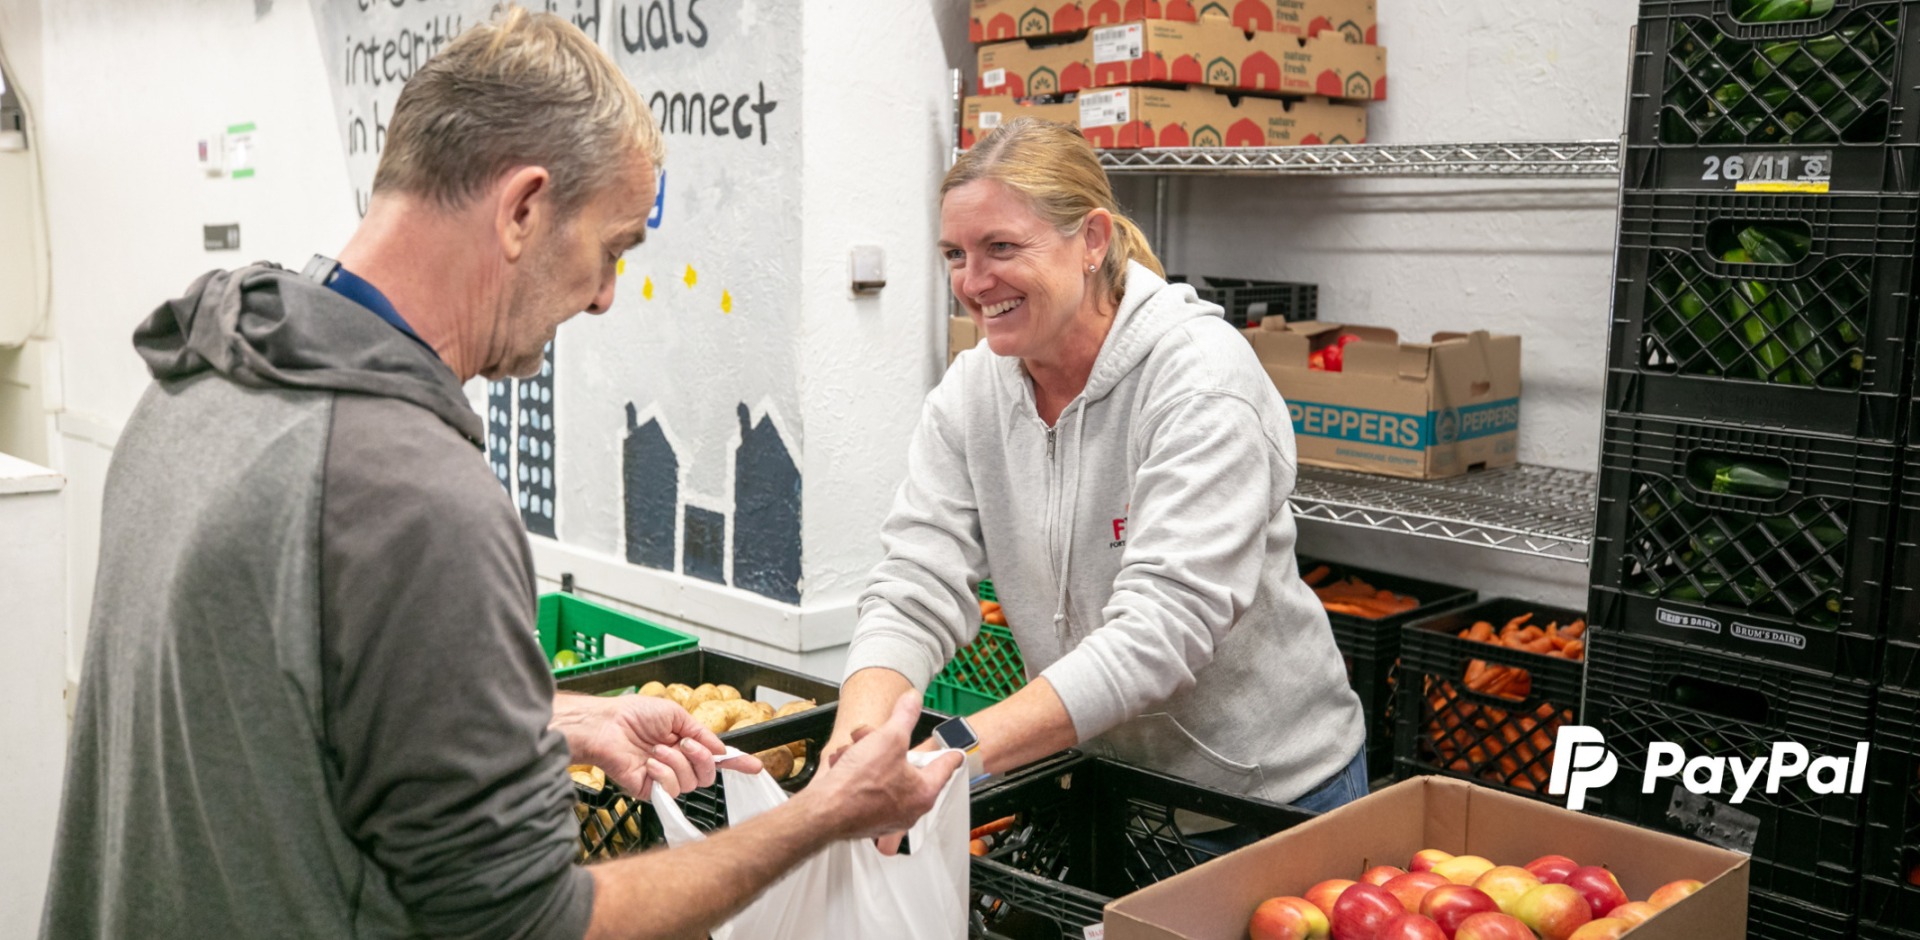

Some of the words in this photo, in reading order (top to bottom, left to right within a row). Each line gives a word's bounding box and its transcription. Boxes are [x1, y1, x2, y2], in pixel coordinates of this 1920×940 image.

[1284, 51, 1312, 62] nature
[1284, 62, 1306, 73] fresh
[649, 80, 777, 146] onnect
[1268, 117, 1296, 128] nature
[1267, 128, 1290, 140] fresh
[1288, 403, 1420, 447] PEPPERS
[1462, 403, 1518, 433] PEPPERS
[1660, 611, 1689, 625] REID'S
[1690, 617, 1717, 630] DAIRY
[1735, 625, 1770, 639] BRUM'S
[1772, 632, 1801, 645] DAIRY
